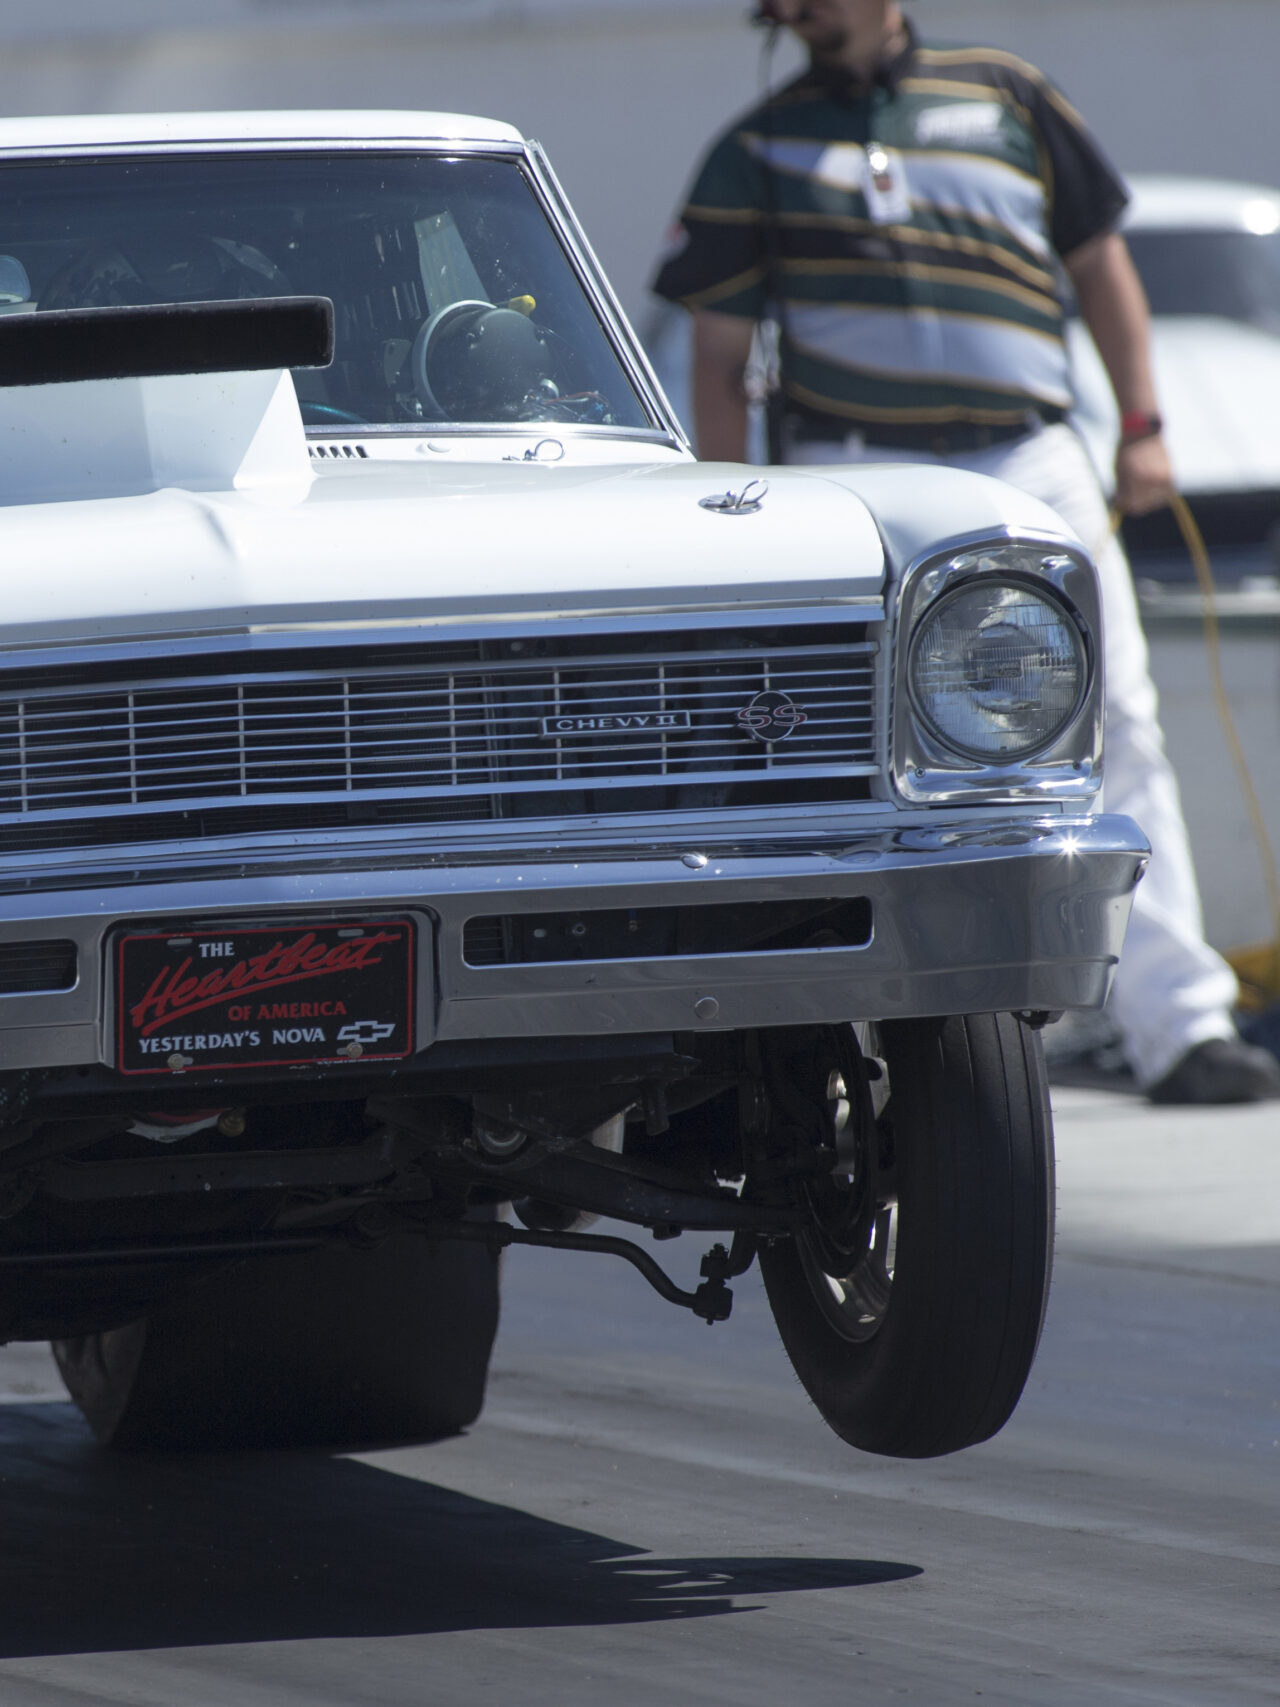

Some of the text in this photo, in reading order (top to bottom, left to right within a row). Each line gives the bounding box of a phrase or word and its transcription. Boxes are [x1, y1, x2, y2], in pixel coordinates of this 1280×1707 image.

[556, 714, 677, 731] CHEVY II
[737, 703, 808, 729] SS
[199, 942, 235, 958] THE
[130, 932, 402, 1032] Heartbeat
[228, 1001, 347, 1022] OF AMERICA
[138, 1028, 326, 1053] YESTERDAY'S NOVA
